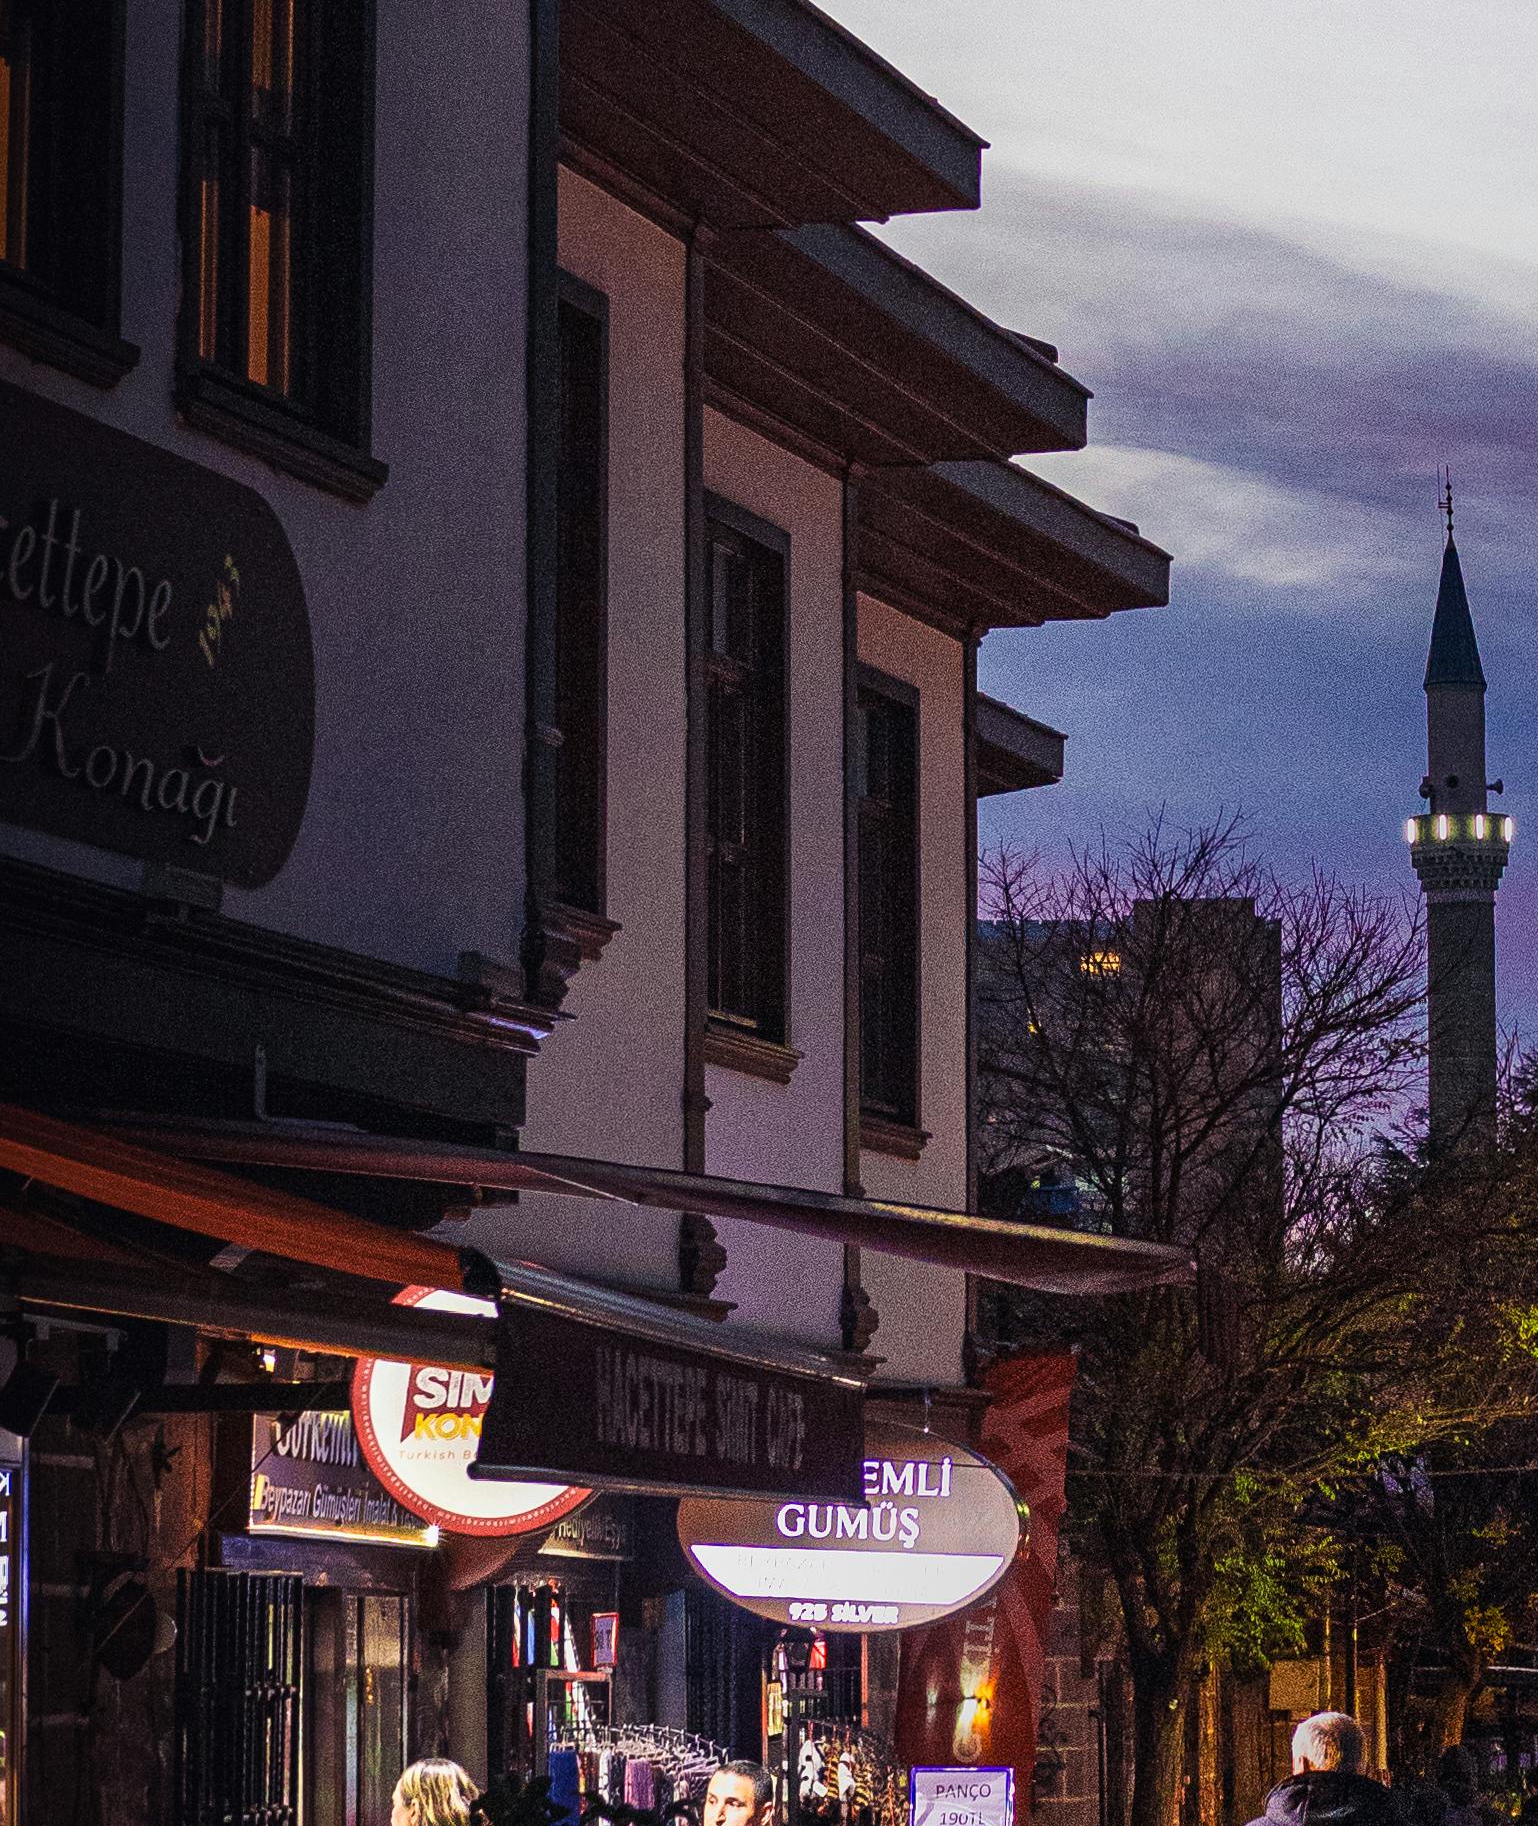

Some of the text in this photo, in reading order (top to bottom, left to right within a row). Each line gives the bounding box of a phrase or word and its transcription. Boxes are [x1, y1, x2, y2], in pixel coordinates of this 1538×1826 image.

[0, 499, 173, 674] ettepe
[0, 662, 238, 845] Konağı
[414, 1412, 484, 1439] KON
[864, 1457, 952, 1497] EMLİ
[936, 1784, 992, 1801] PANÇO
[939, 1812, 985, 1826] 190TL
